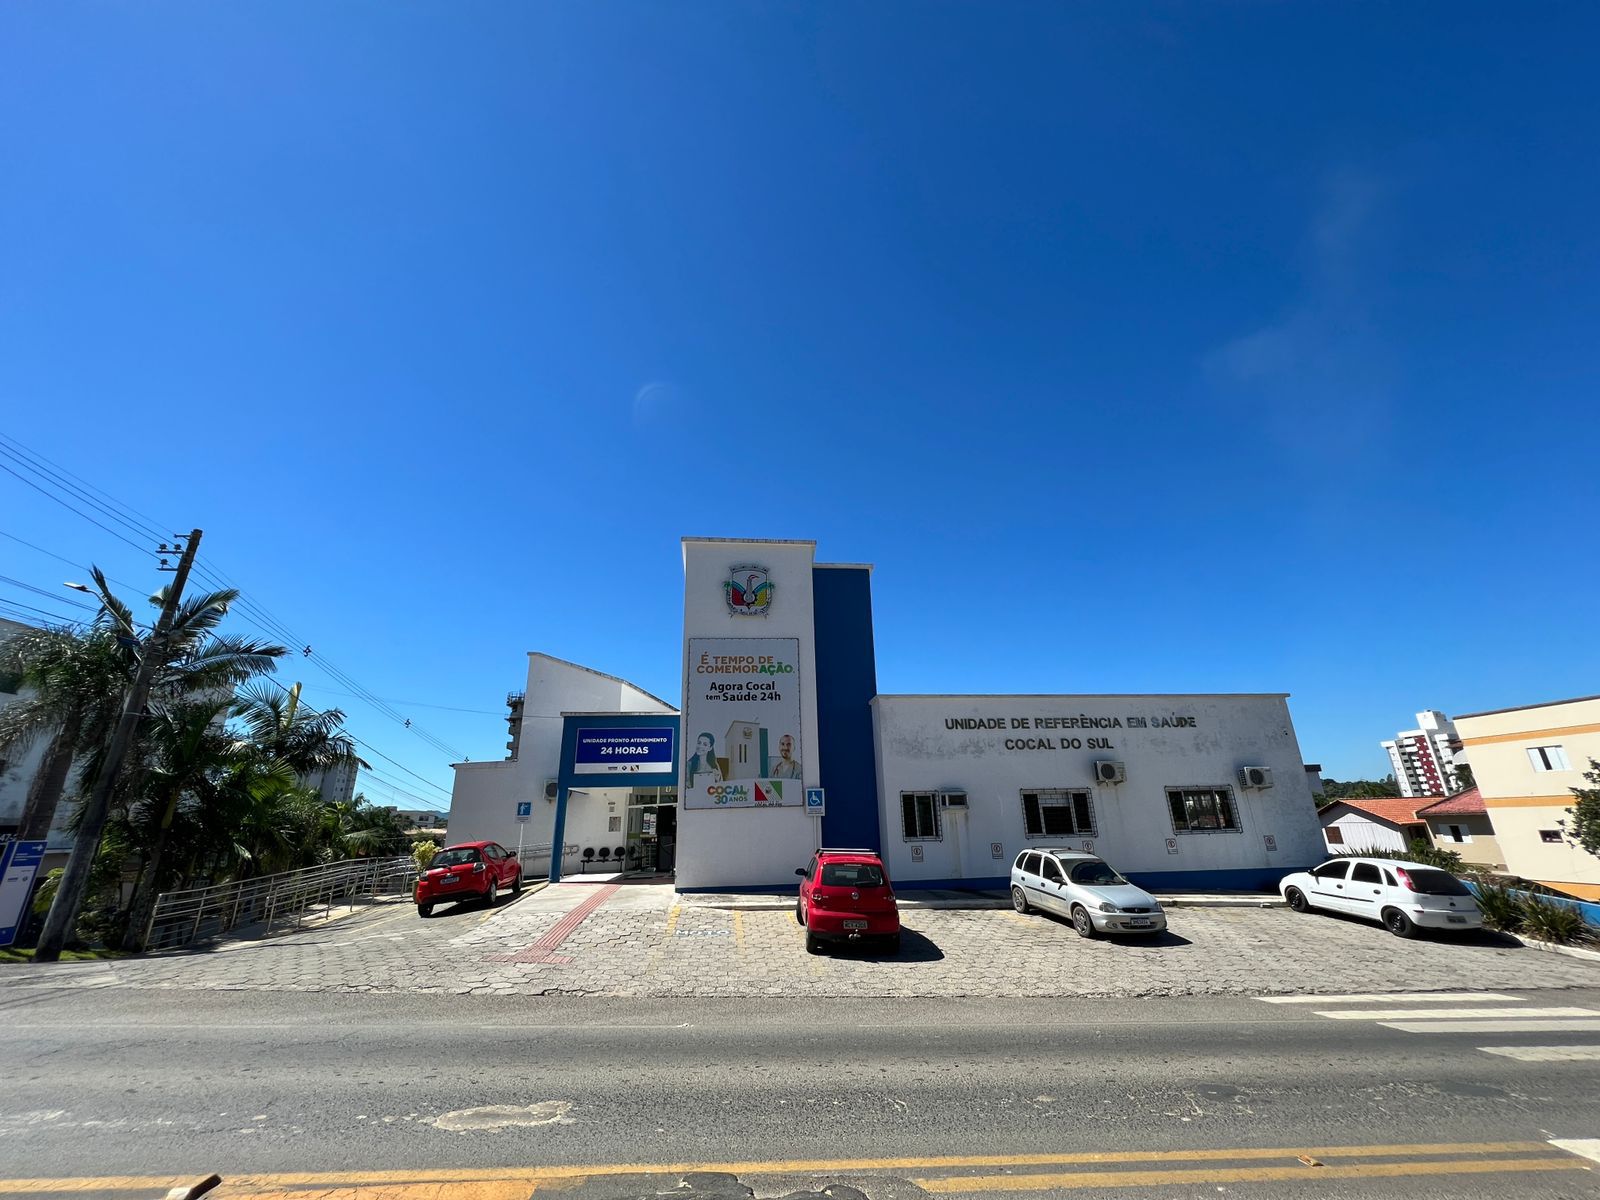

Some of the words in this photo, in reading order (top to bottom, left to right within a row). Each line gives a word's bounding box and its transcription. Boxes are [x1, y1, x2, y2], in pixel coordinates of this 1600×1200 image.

[701, 651, 709, 665] É
[713, 656, 755, 665] TEMPO
[758, 656, 774, 664] DE
[709, 681, 743, 693] Agora
[746, 681, 775, 691] Cocal
[722, 691, 758, 702] Saúde
[760, 691, 782, 701] 24h
[945, 718, 1007, 730] UNIDADE
[1011, 718, 1031, 730] DE
[1034, 714, 1123, 729] REFERÊNCIA
[1126, 716, 1148, 729] EM
[1151, 712, 1197, 729] SAÚDE
[1004, 738, 1057, 750] COCAL
[1061, 738, 1082, 750] DO
[1087, 738, 1115, 750] SUL
[600, 746, 613, 755] 24
[615, 746, 649, 755] HORAS
[707, 785, 748, 796] COCAL
[714, 795, 729, 805] 30
